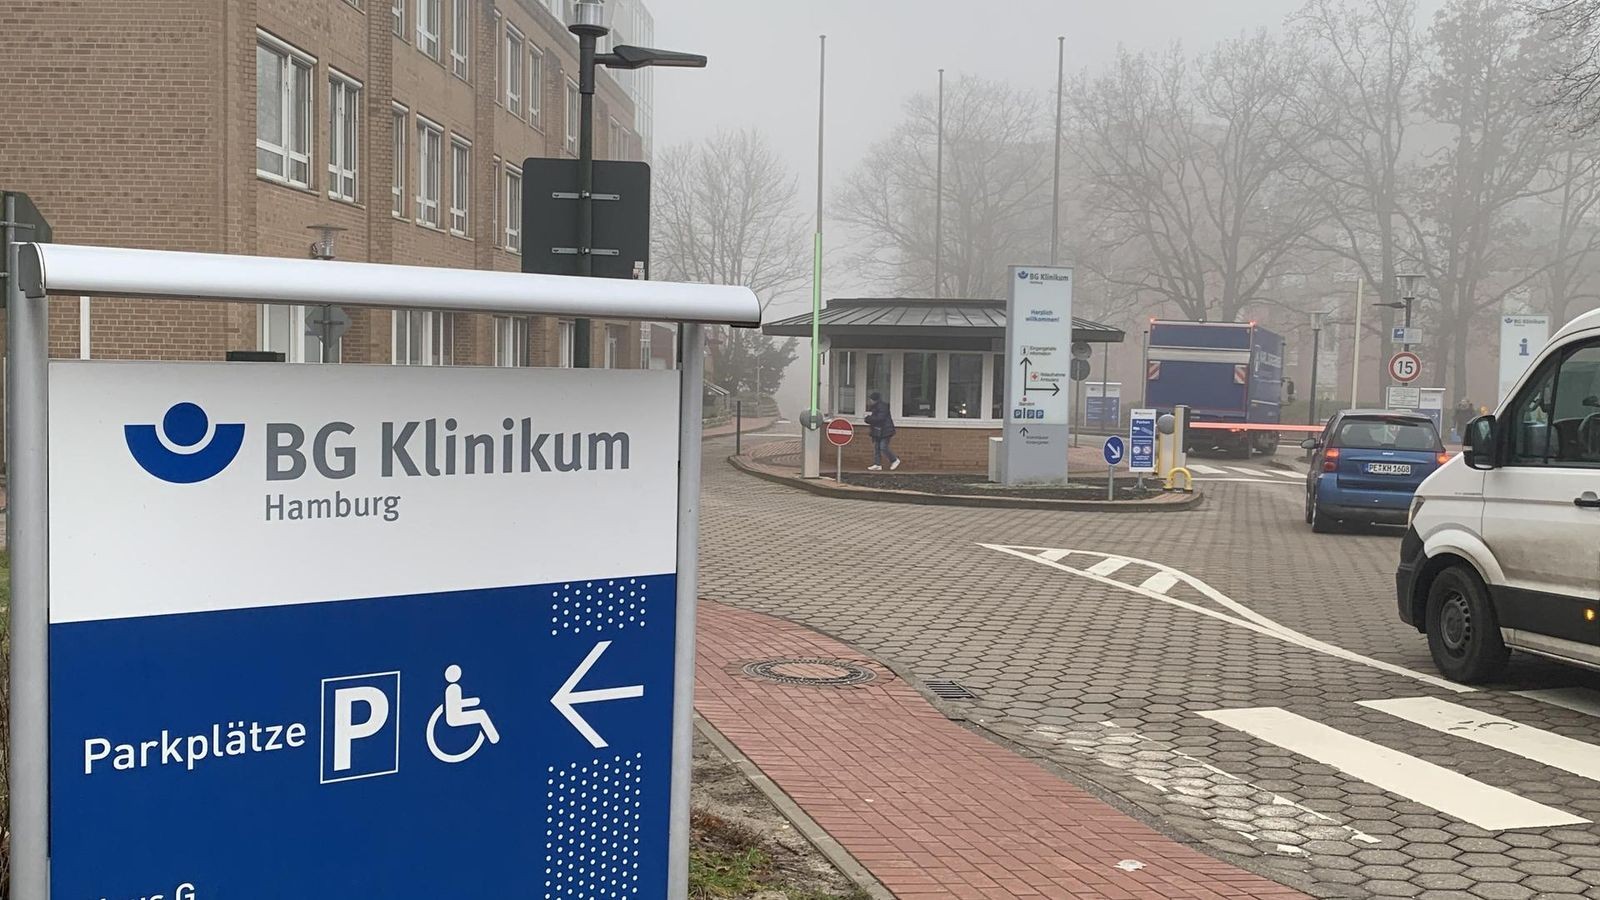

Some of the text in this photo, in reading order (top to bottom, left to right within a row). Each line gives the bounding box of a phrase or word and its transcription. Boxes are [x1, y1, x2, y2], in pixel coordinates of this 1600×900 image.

[1040, 272, 1068, 281] Klinikum
[1398, 360, 1413, 374] 15
[267, 417, 629, 481] BG Klinikum
[266, 491, 401, 521] Hamburg
[85, 721, 305, 774] Parkplätze
